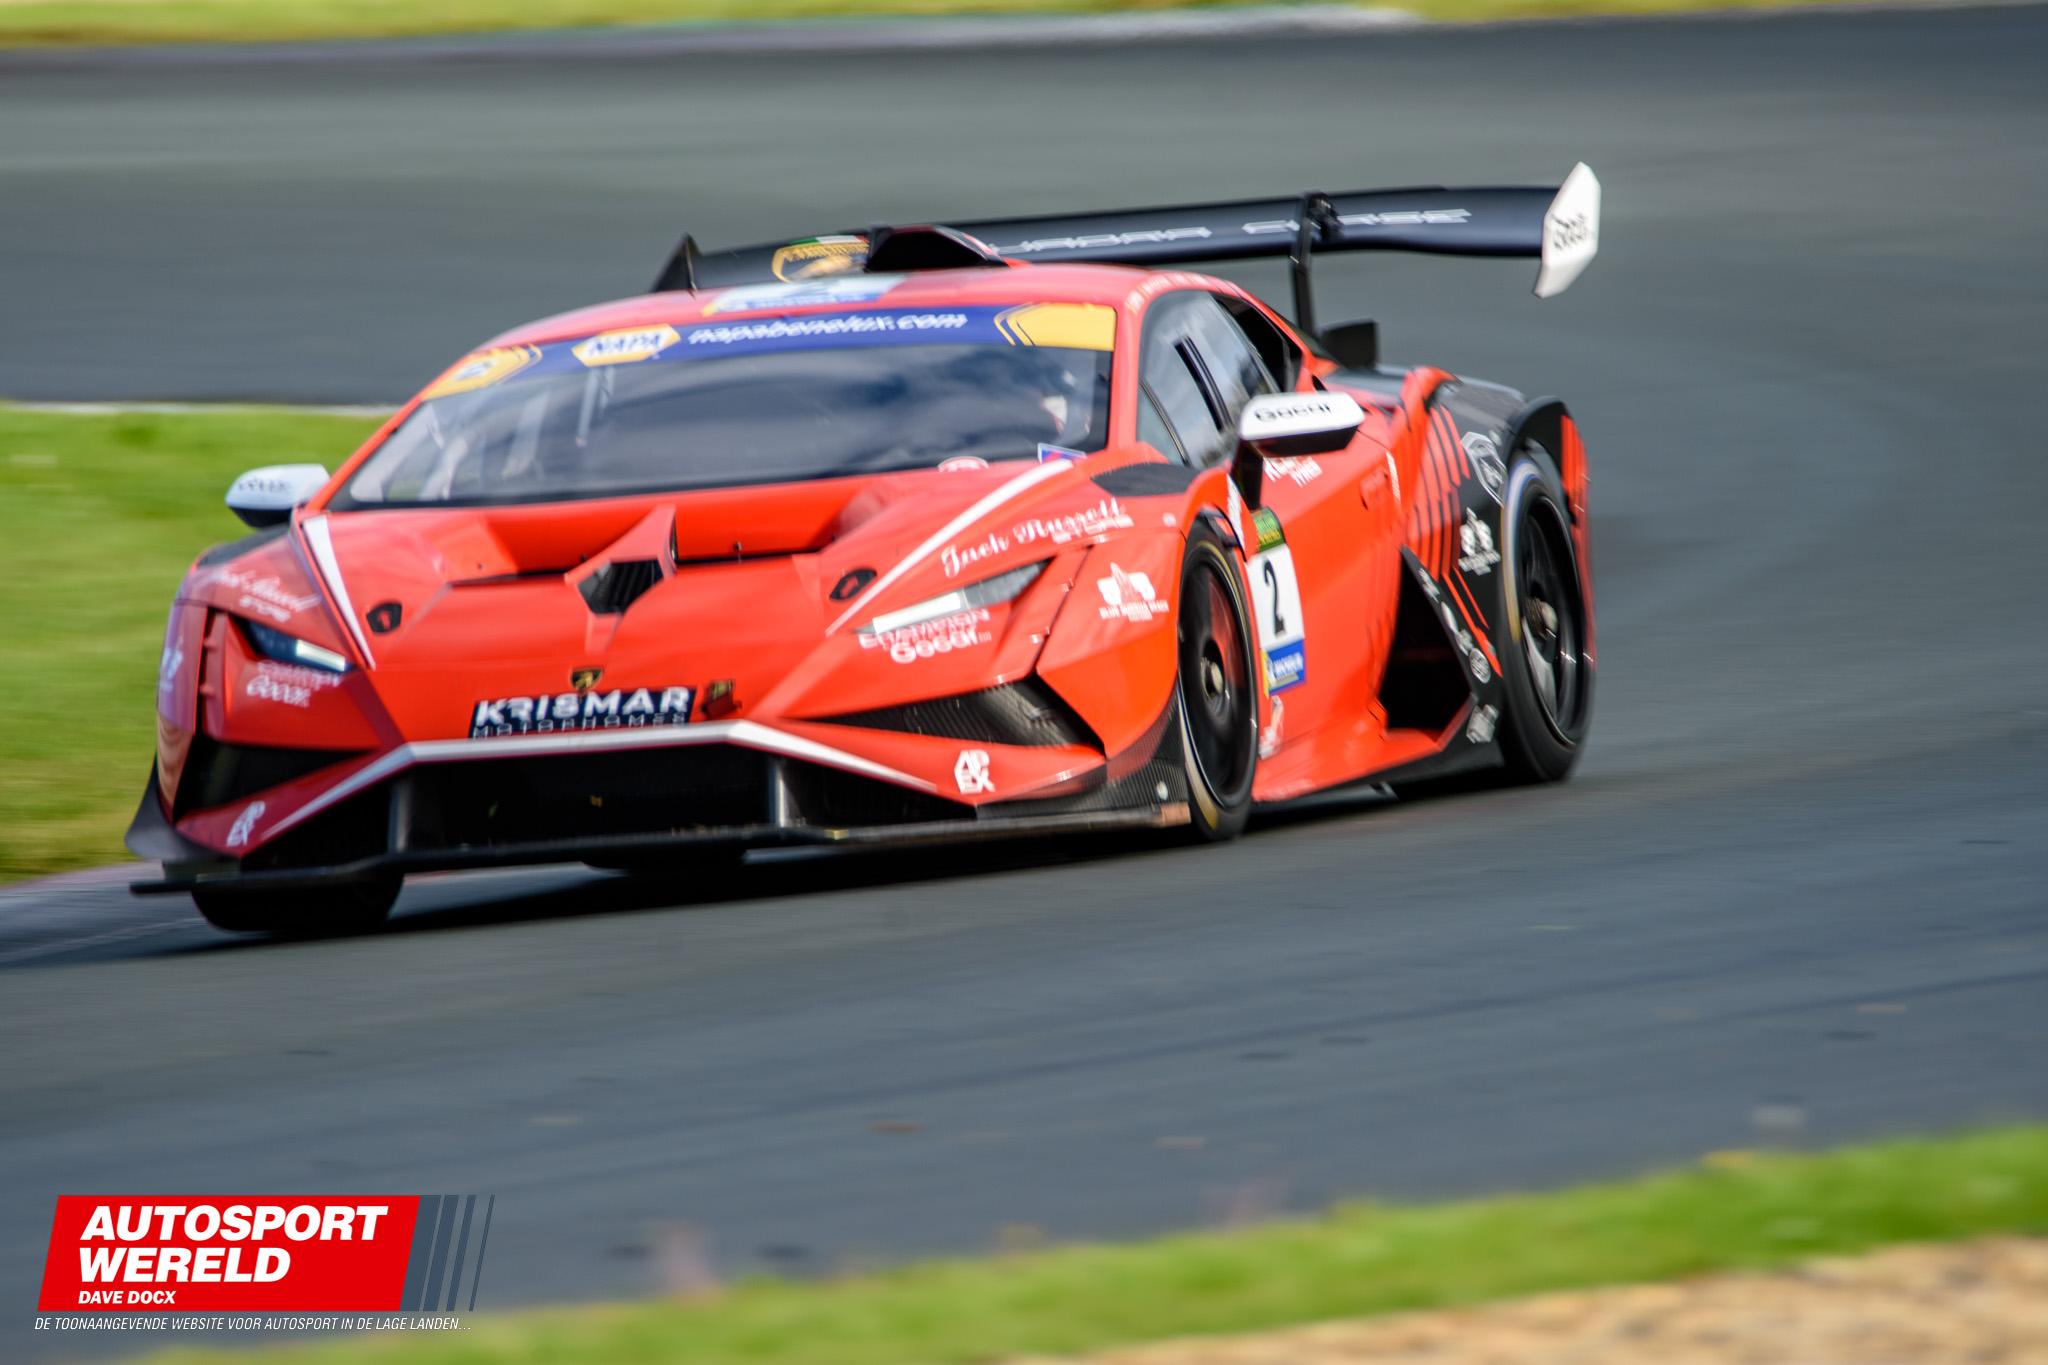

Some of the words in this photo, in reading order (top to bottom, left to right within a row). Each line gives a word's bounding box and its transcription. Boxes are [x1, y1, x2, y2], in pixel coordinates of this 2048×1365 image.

[688, 313, 968, 345] napabenelux.com
[1013, 496, 1128, 545] Russell
[1262, 557, 1288, 638] 2
[476, 686, 691, 727] KRISMAR
